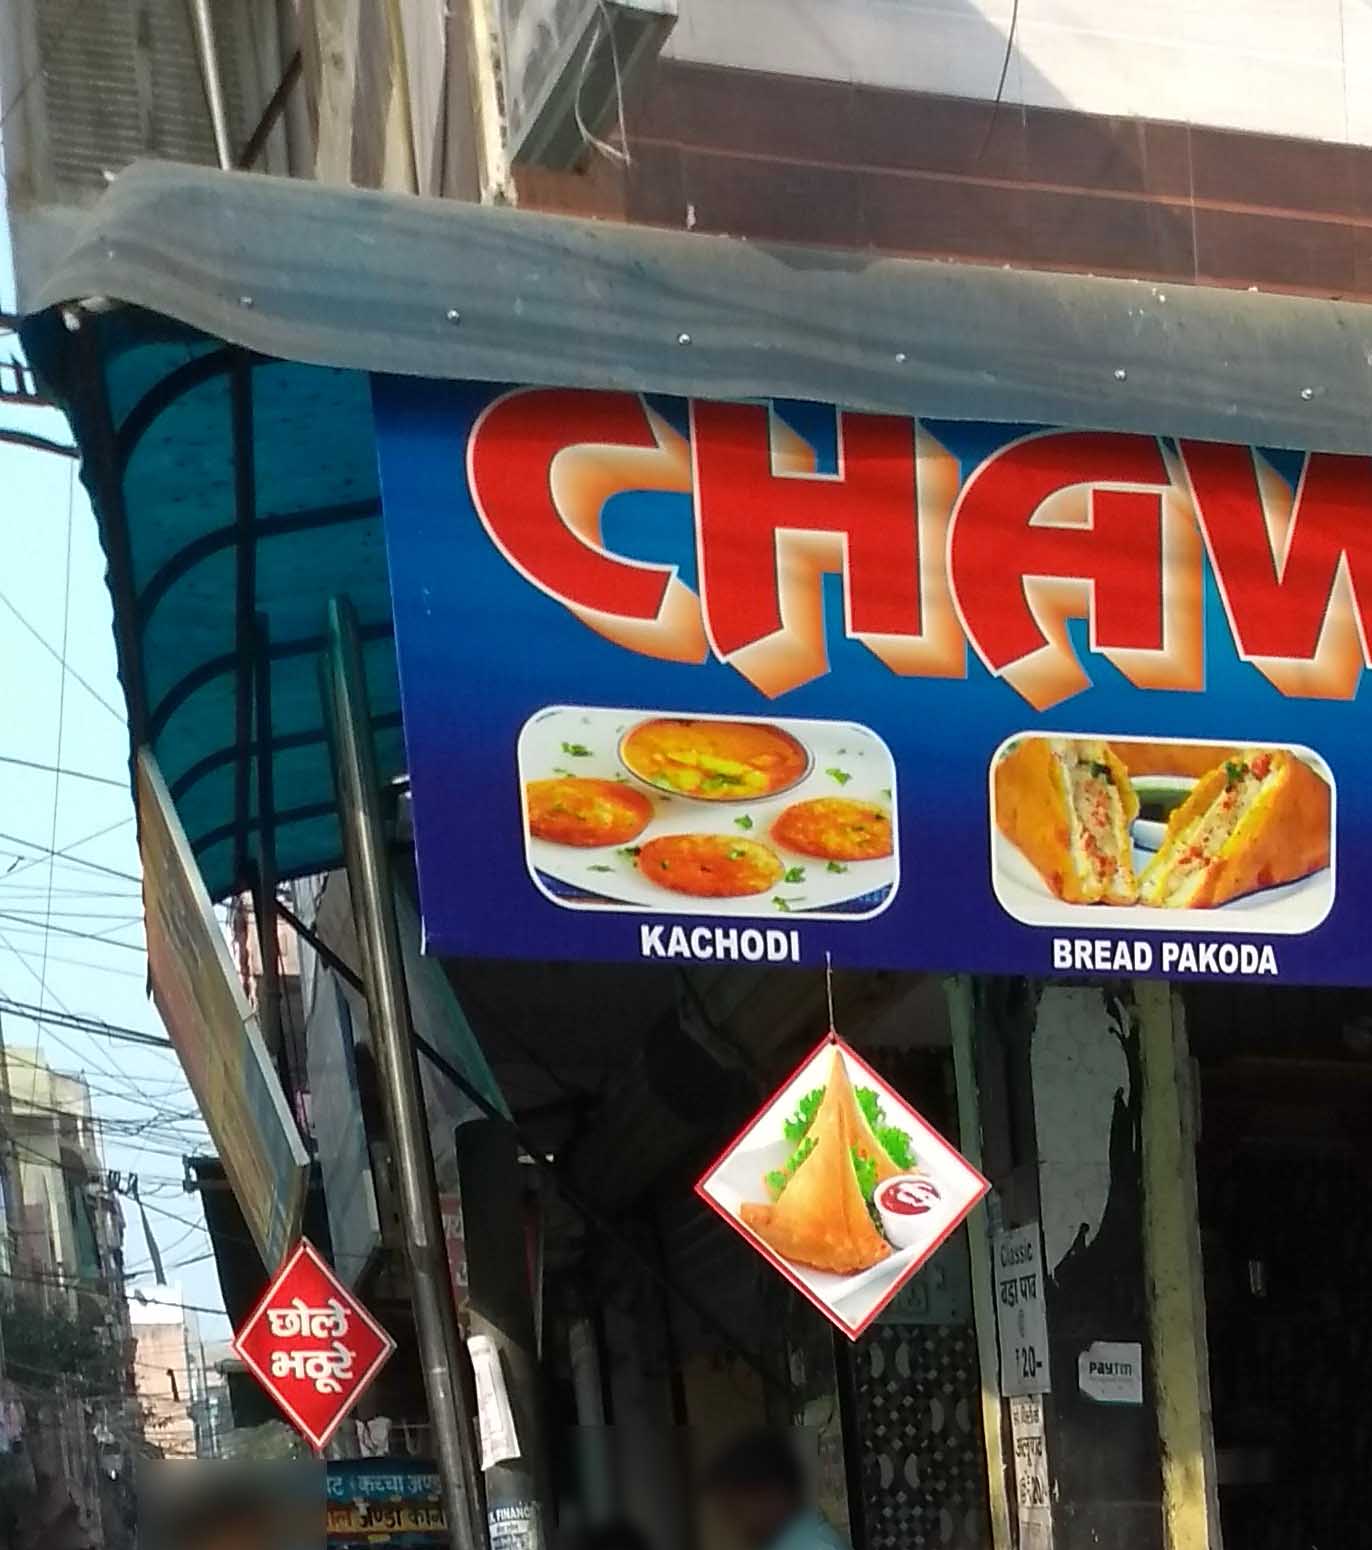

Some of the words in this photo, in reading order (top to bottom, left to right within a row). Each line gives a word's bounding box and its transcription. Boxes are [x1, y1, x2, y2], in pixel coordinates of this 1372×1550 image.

[640, 925, 800, 962] KACHODI
[1053, 939, 1153, 974] BREAD
[1162, 942, 1278, 976] PAKODA
[267, 1298, 351, 1338] छोले
[271, 1341, 356, 1394] भठूरे
